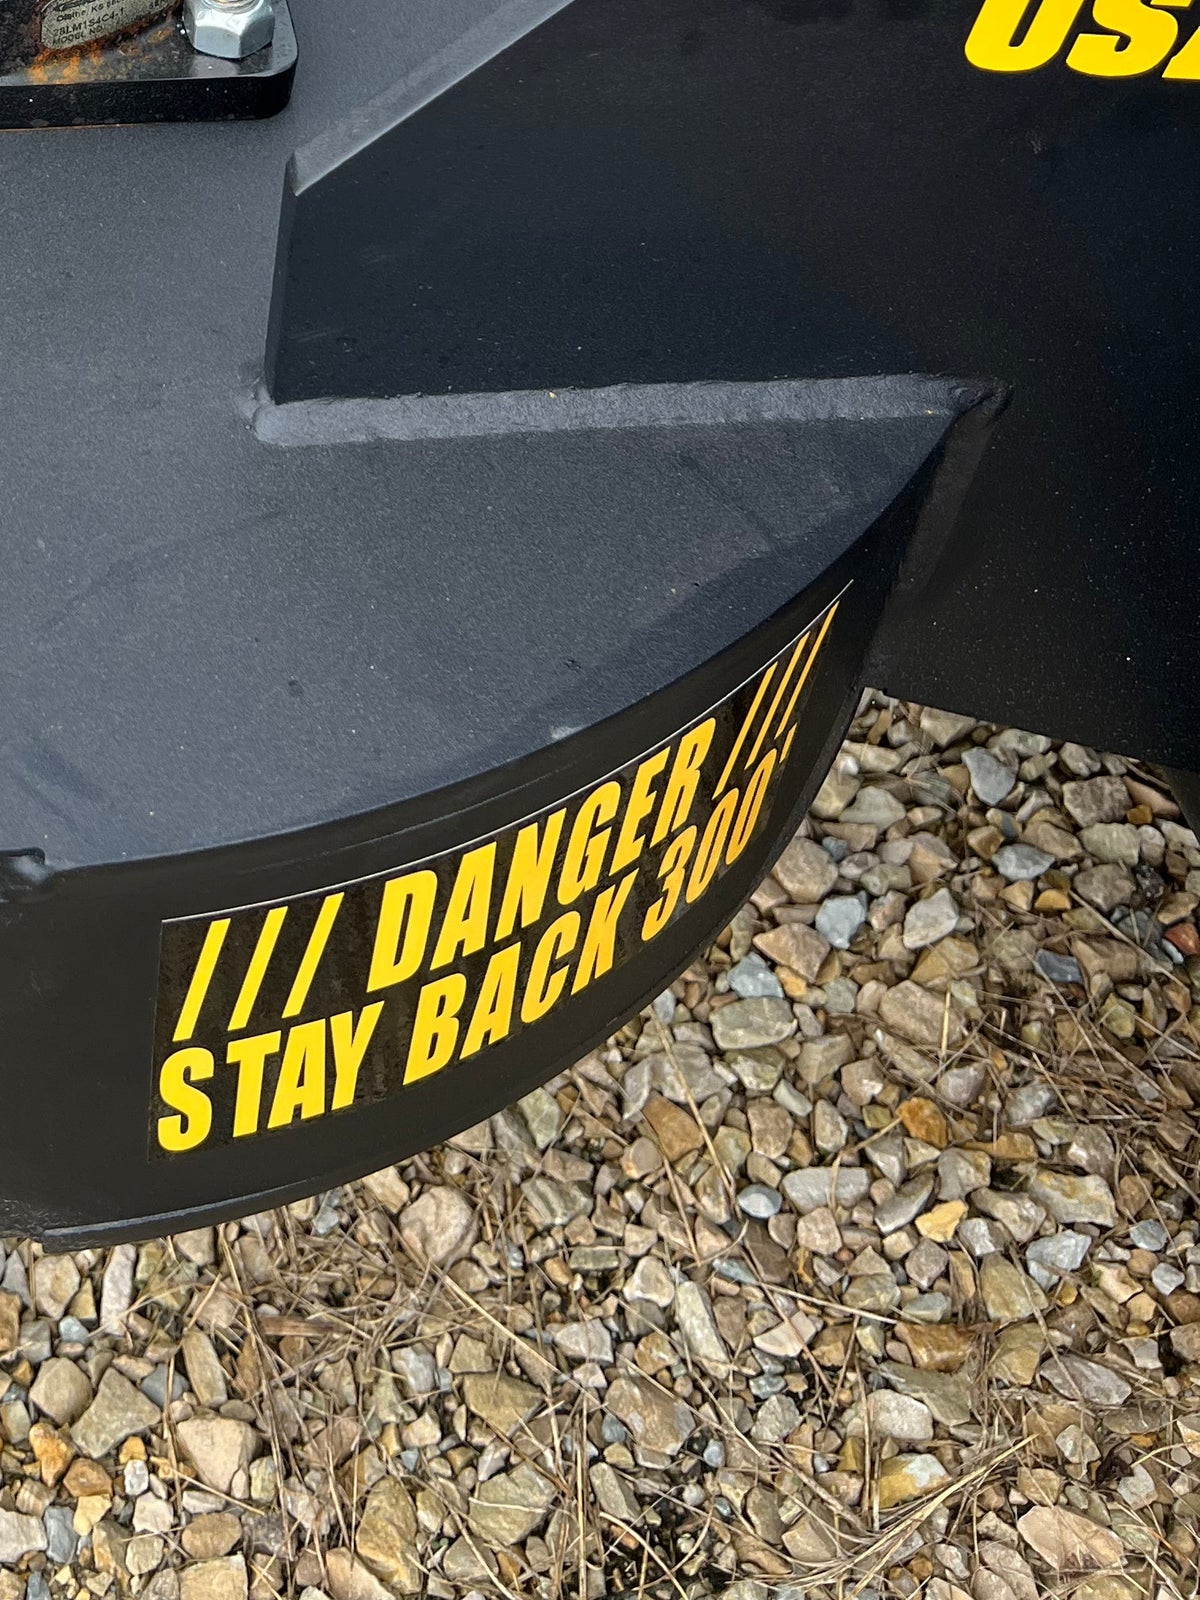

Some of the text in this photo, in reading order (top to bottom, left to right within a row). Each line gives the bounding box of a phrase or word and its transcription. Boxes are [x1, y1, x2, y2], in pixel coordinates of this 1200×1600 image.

[367, 717, 717, 994] DANGER
[158, 1002, 385, 1153] STAY
[402, 869, 639, 1085] BACK
